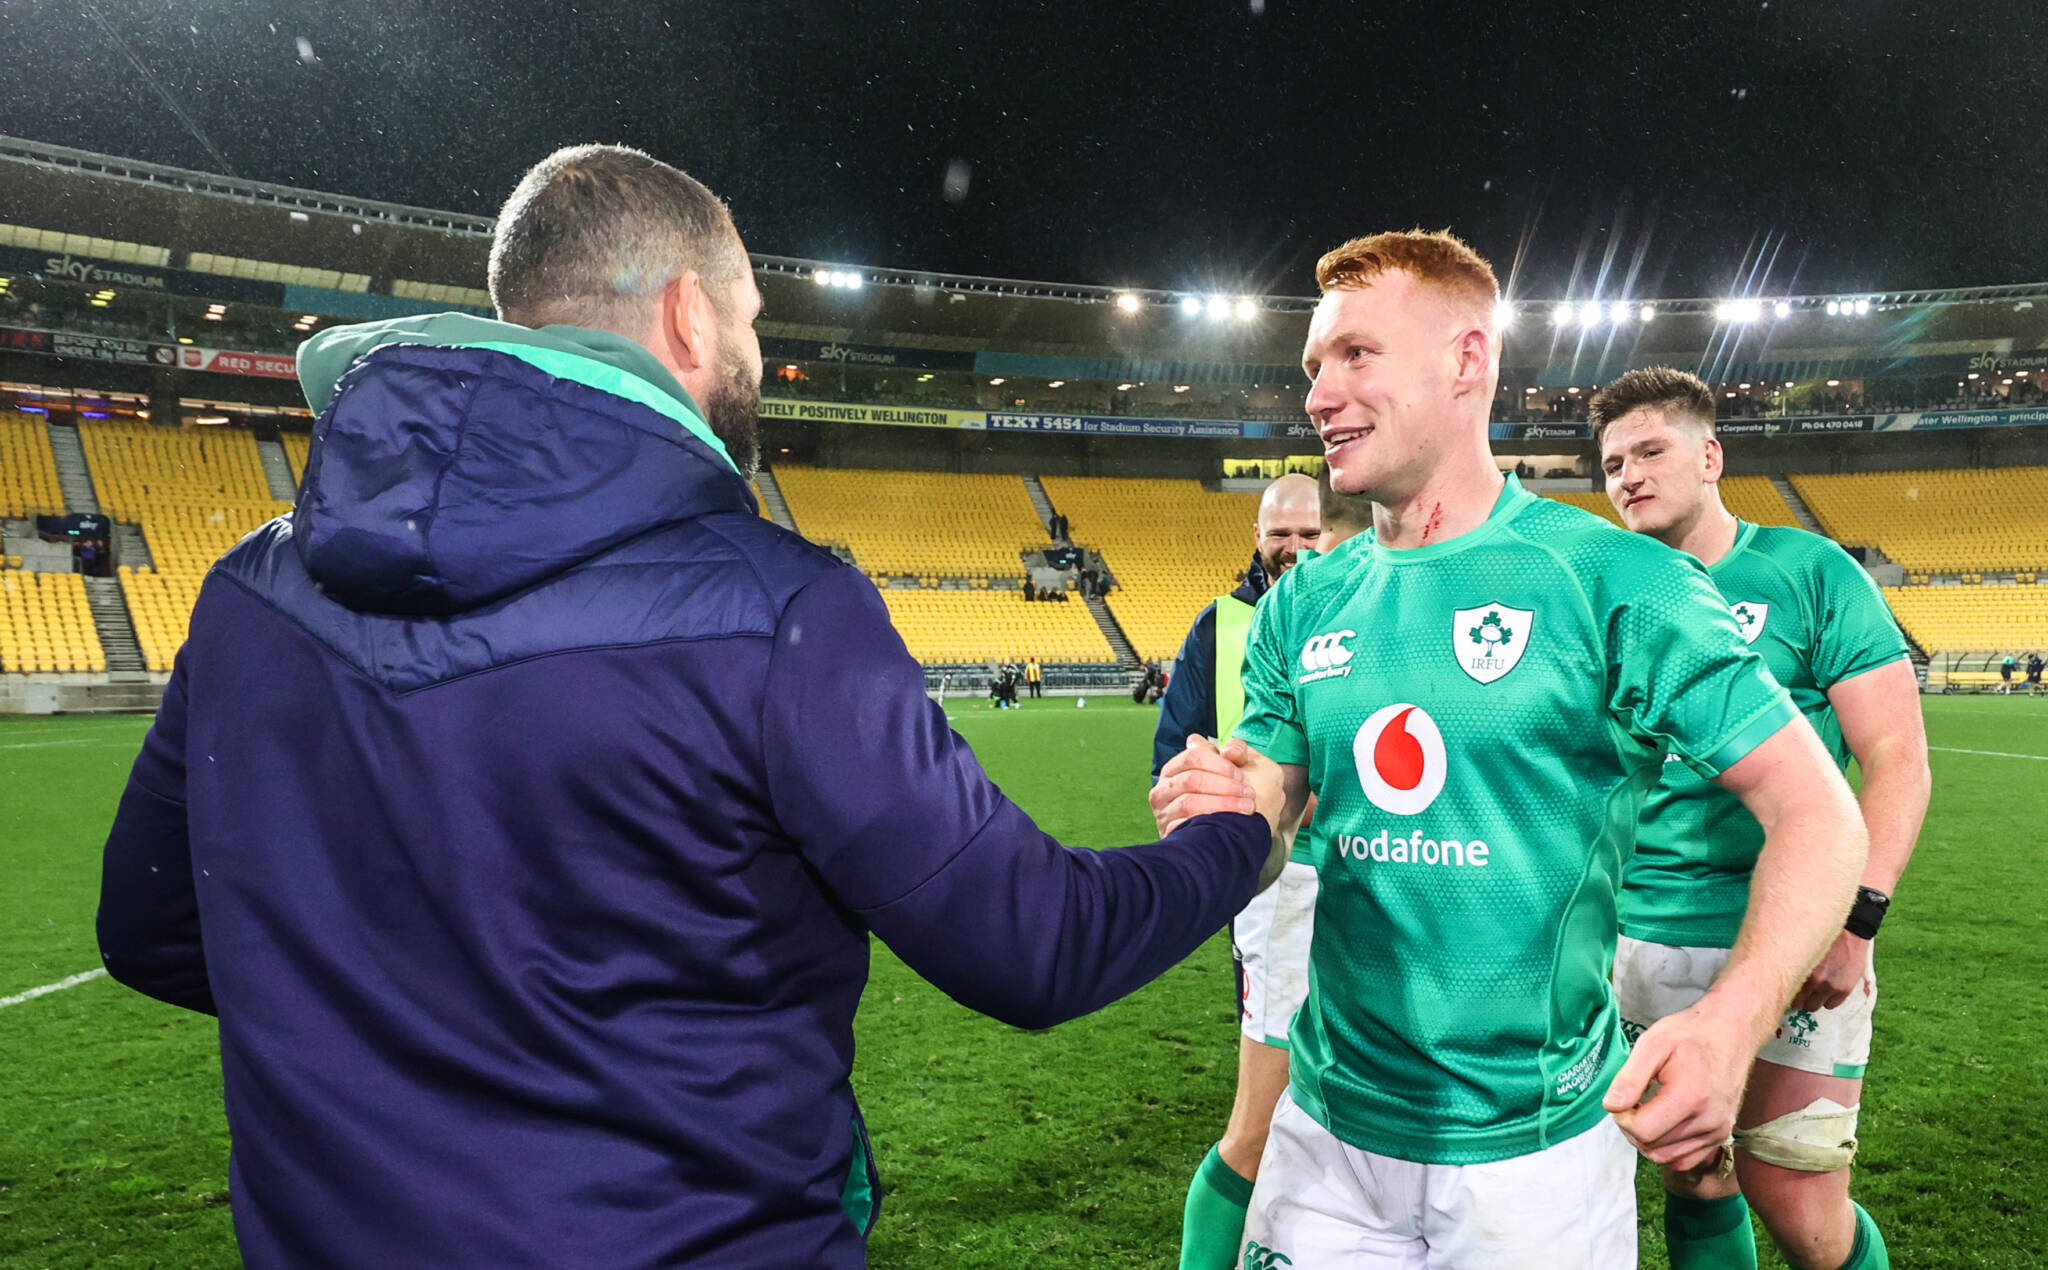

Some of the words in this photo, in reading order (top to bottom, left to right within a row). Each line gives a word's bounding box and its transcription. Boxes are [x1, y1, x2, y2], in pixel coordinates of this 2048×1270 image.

[45, 254, 95, 283] sky
[93, 268, 164, 288] STADIUM
[219, 356, 250, 369] RED
[255, 360, 296, 374] SECU
[799, 405, 867, 421] POSITIVELY
[871, 410, 948, 425] WELLINGTON
[1941, 413, 1998, 425] Wellington
[990, 415, 1040, 429] TEXT
[1042, 417, 1081, 431] 5454
[1083, 421, 1098, 431] for
[1100, 422, 1142, 433] Stadium
[1142, 423, 1186, 436] Security
[1187, 424, 1240, 436] Assistance
[1470, 658, 1505, 671] IRFU
[1338, 829, 1490, 867] vodafone
